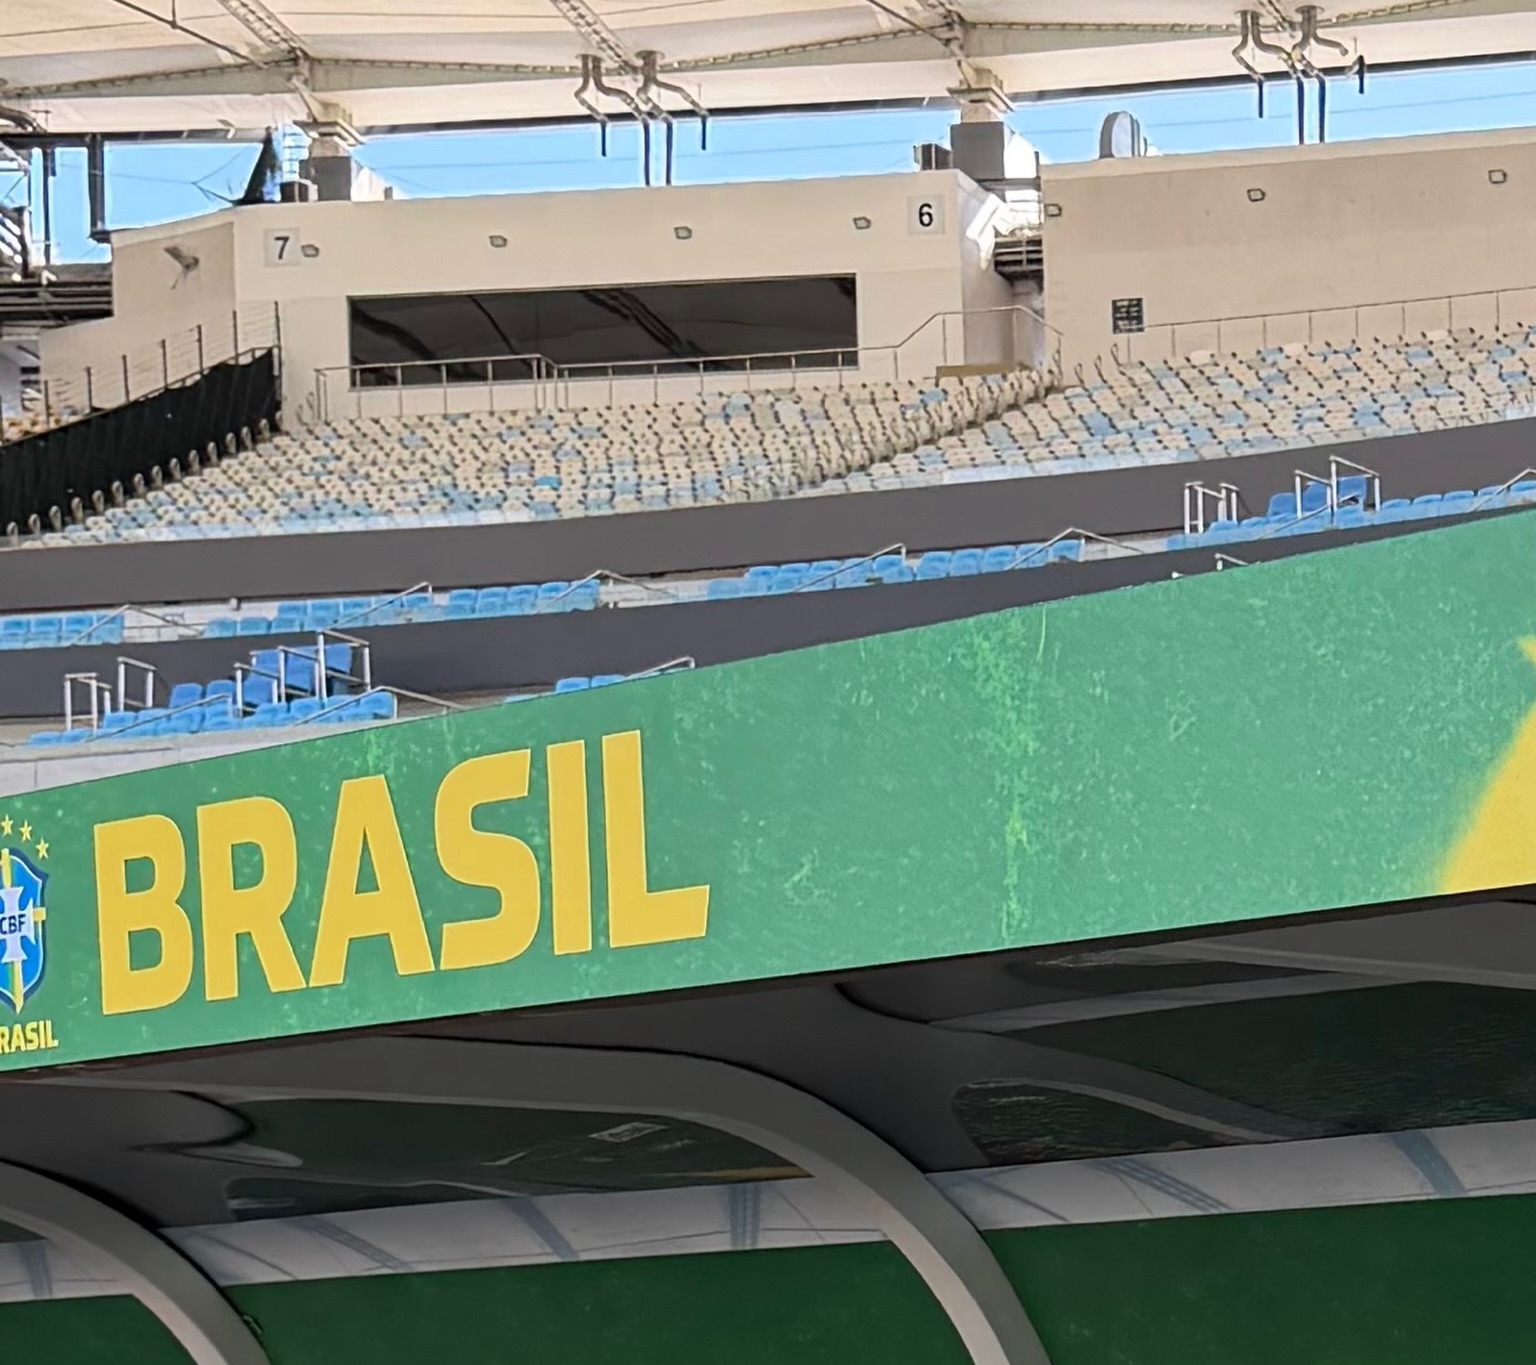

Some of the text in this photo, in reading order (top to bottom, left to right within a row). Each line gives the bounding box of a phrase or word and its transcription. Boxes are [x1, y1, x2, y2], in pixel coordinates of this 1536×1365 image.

[918, 203, 933, 228] 6
[274, 236, 290, 260] 7
[93, 729, 710, 1015] BRASIL
[0, 914, 27, 935] CBF
